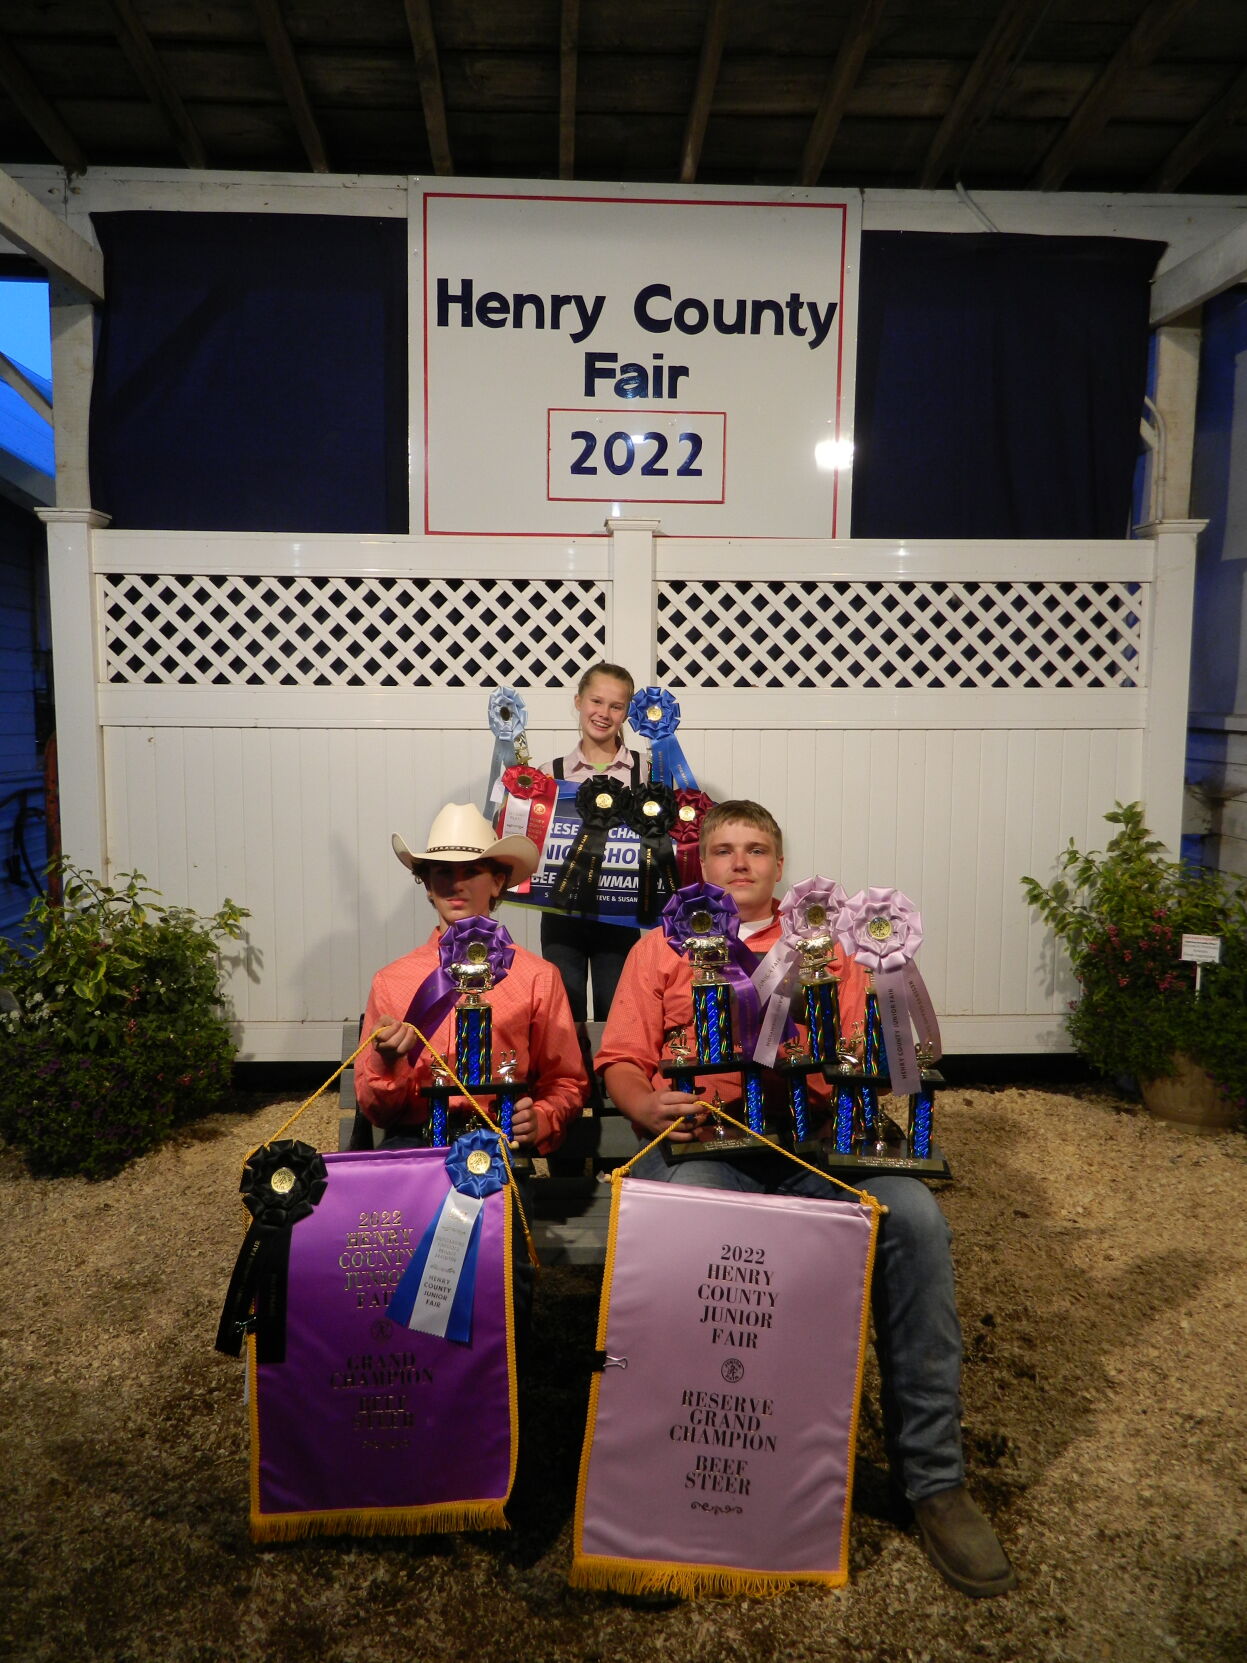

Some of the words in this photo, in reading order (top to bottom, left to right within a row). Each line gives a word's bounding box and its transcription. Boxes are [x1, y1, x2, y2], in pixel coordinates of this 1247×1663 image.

[436, 278, 606, 343] Henry
[633, 283, 838, 350] County
[583, 352, 690, 399] Fair
[569, 431, 703, 477] 2022
[550, 822, 580, 836] RESE
[601, 847, 640, 865] SHO
[531, 871, 557, 884] BEE
[617, 895, 639, 903] SUSAN
[888, 988, 896, 1004] FAIR
[891, 1004, 900, 1029] JUNIOR
[895, 1029, 904, 1057] COUNTY
[897, 1058, 907, 1080] HENRY
[358, 1210, 402, 1229] 2022
[346, 1228, 414, 1249] HENRY
[338, 1248, 416, 1269] COUNTY
[720, 1244, 765, 1265] 2022
[344, 1268, 407, 1291] JUNIO
[428, 1275, 451, 1285] HENRY
[706, 1263, 774, 1287] HENRY
[423, 1282, 452, 1294] COUNTY
[423, 1290, 448, 1301] JUNIOR
[697, 1284, 779, 1308] COUNTY
[355, 1291, 393, 1309] FAI
[425, 1298, 441, 1308] FAIR
[699, 1304, 773, 1329] JUNIOR
[711, 1327, 758, 1349] FAIR
[347, 1352, 417, 1370] GRAND
[330, 1368, 434, 1389] CHAMPION
[680, 1389, 774, 1416] RESERVE
[352, 1412, 417, 1432] STEER
[689, 1408, 761, 1432] GRAND
[669, 1425, 777, 1453] CHAMPION
[695, 1455, 749, 1476] BEEF
[684, 1472, 751, 1496] STEER
